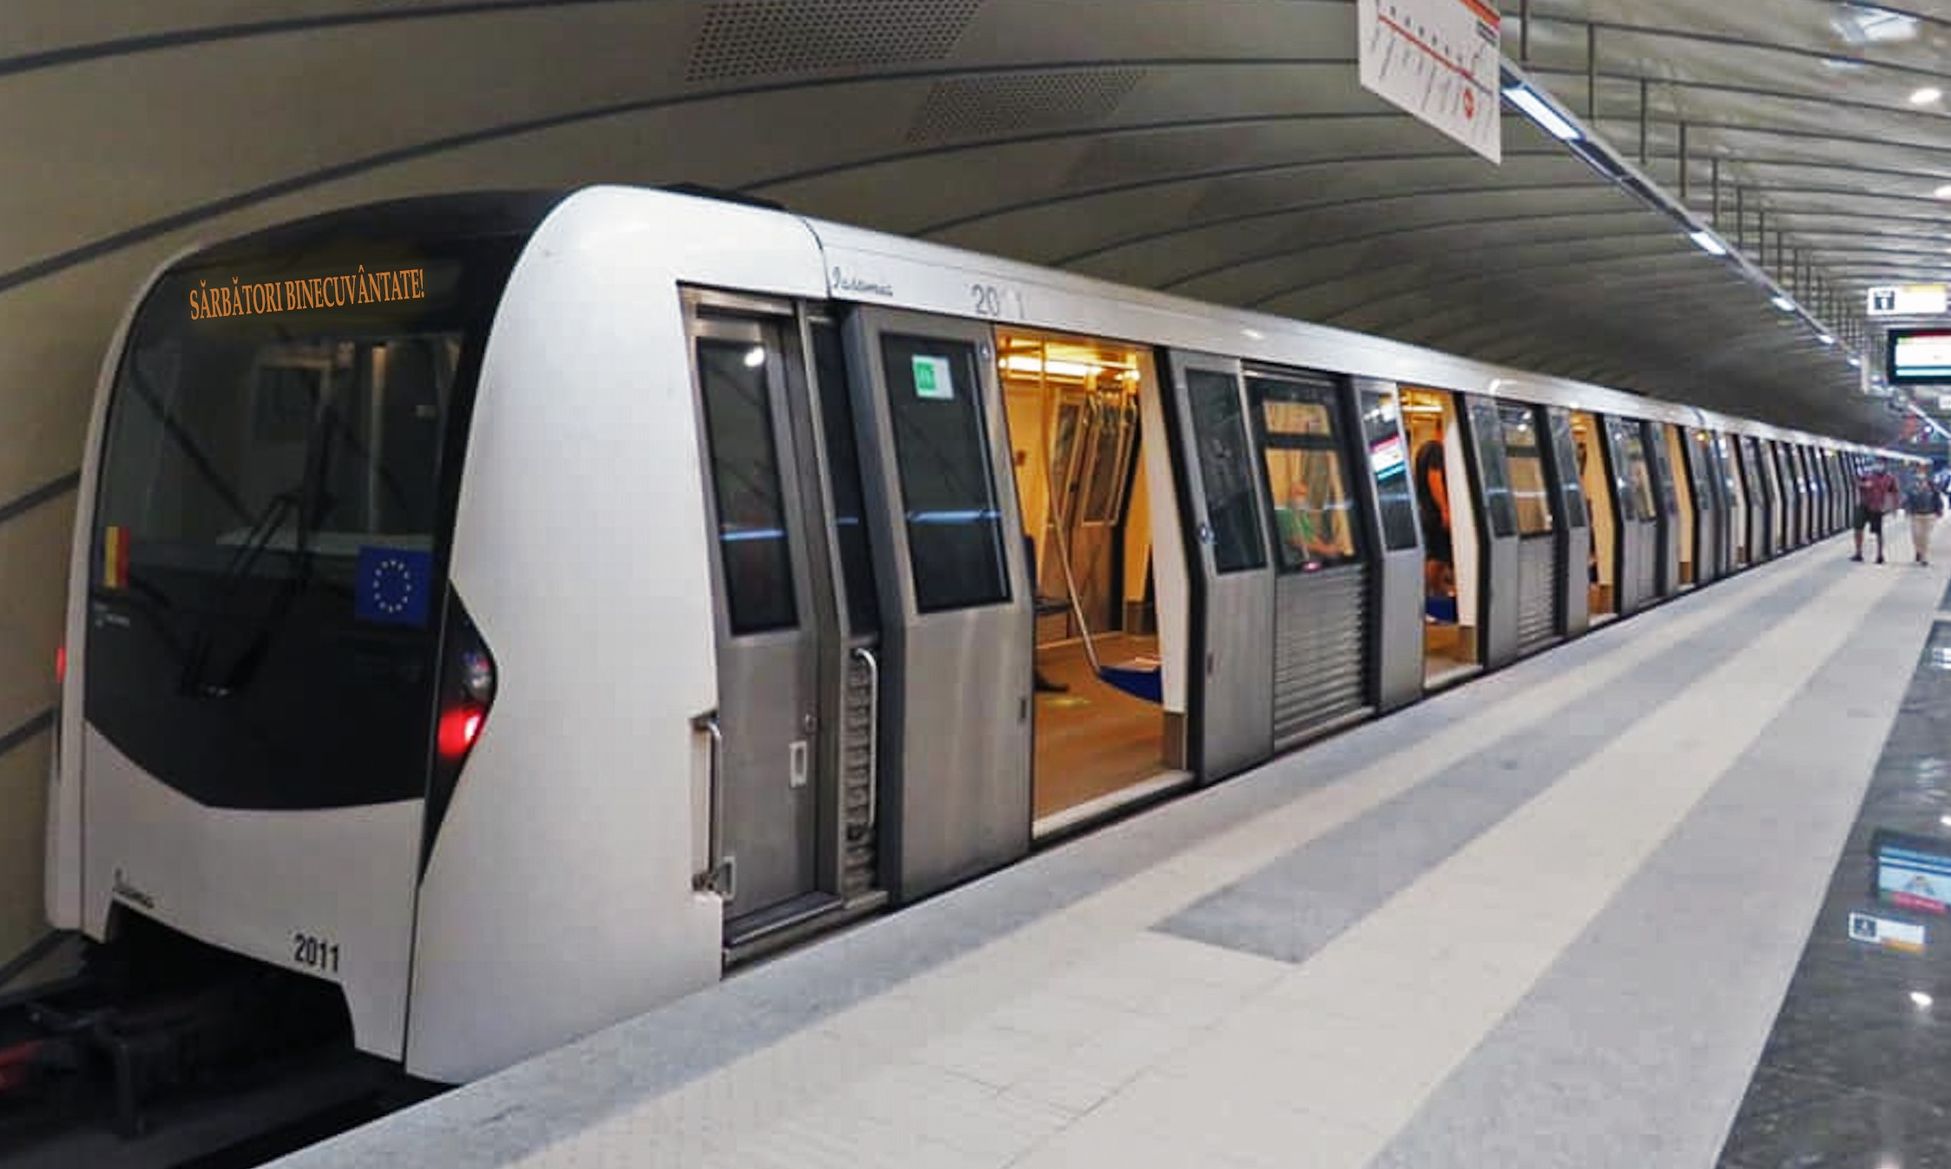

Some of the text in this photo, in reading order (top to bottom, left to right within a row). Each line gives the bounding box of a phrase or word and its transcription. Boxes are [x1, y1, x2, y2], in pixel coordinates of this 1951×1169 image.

[189, 263, 425, 320] SĂRBĂTORI BINECUVÂNTATE!
[971, 284, 1025, 319] 201
[294, 933, 339, 973] 2011
